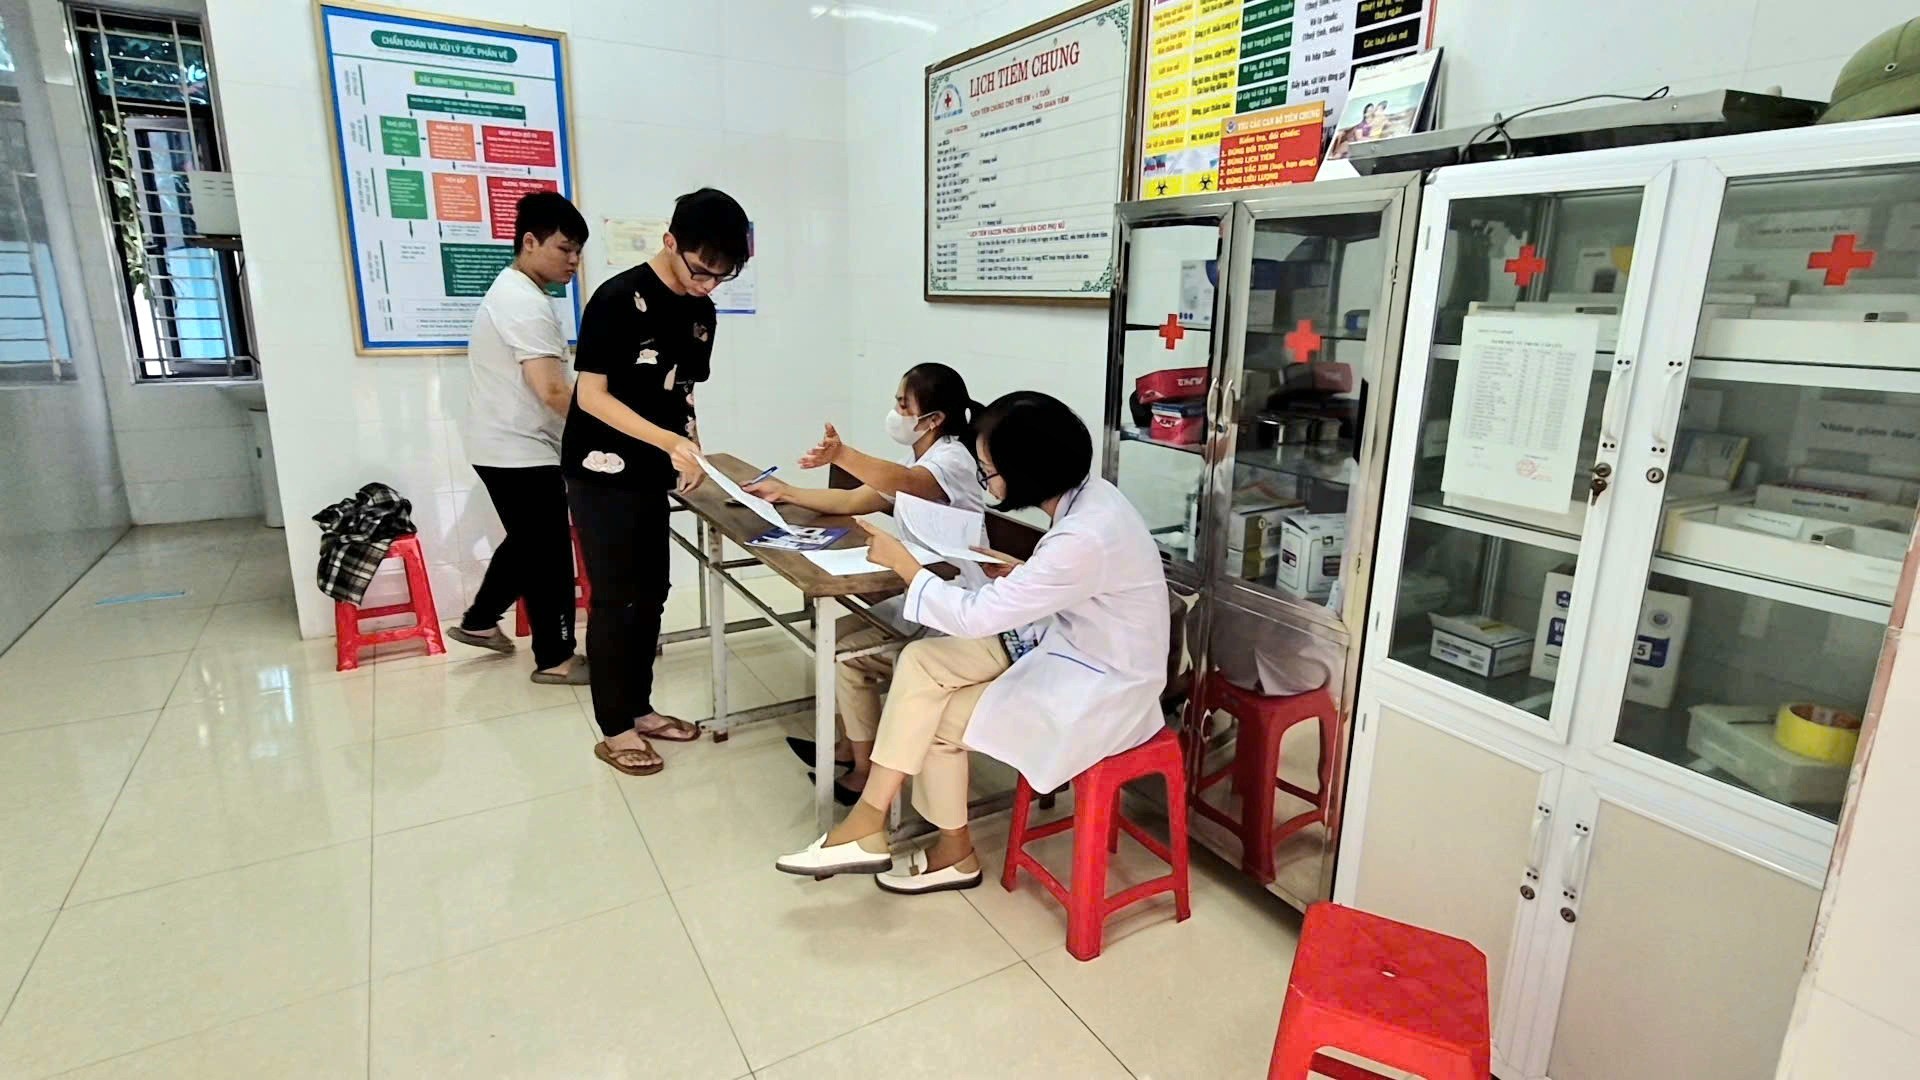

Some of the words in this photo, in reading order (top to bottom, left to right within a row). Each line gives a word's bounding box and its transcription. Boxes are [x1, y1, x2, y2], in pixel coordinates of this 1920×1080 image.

[969, 75, 995, 102] LỊCH
[998, 57, 1029, 88] TIÊM
[1031, 38, 1080, 77] CHỦNG
